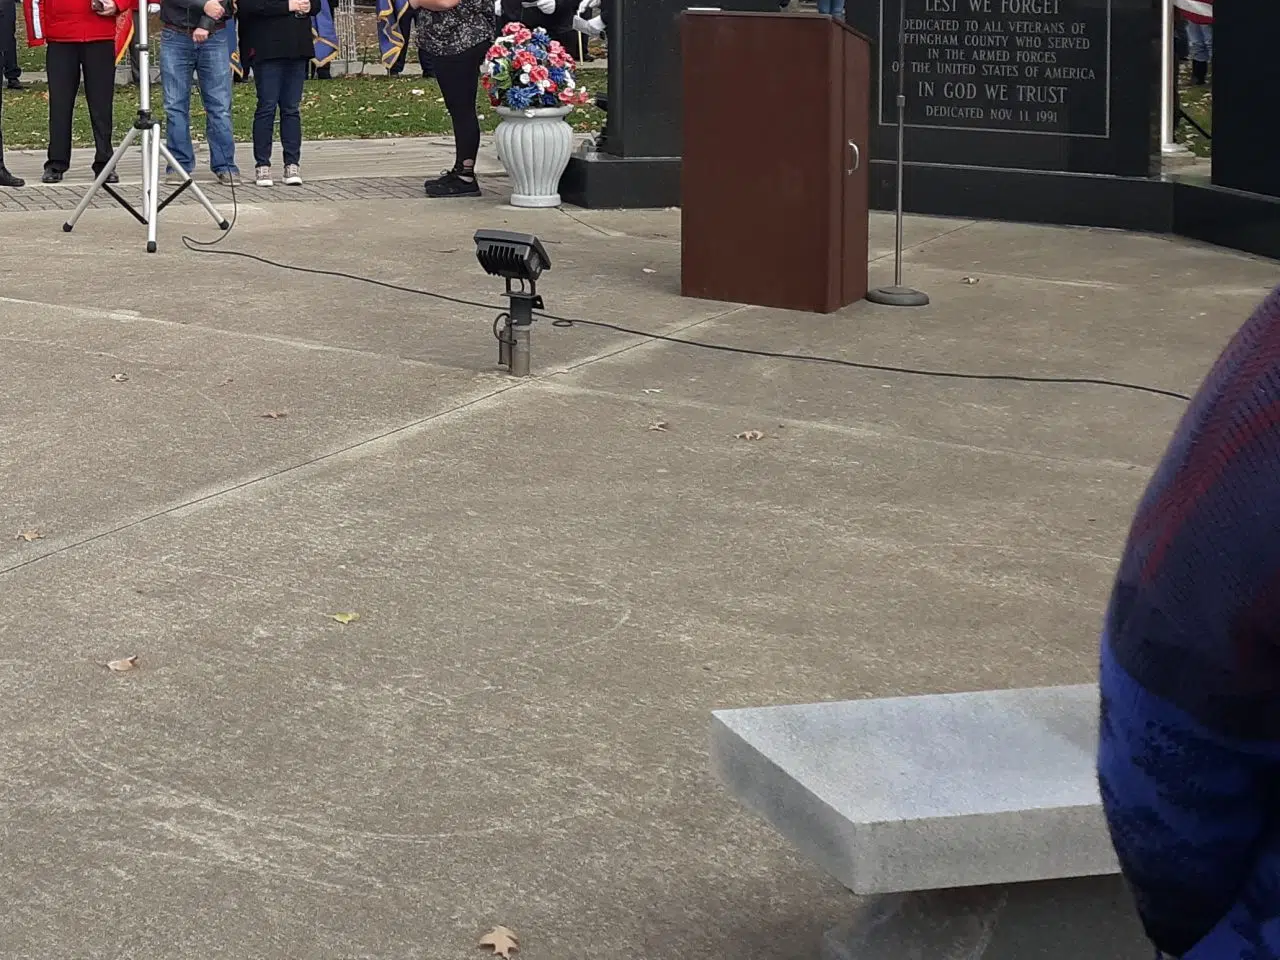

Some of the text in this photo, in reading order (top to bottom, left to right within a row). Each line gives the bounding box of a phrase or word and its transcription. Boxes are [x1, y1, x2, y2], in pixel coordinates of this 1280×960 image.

[903, 18, 1088, 35] DEDICATED TO ALL VETERANS OF
[964, 34, 1009, 47] COUNTY
[1015, 35, 1041, 48] WHO
[1047, 36, 1091, 50] SERVED
[928, 47, 1057, 64] IN THE ARMED FORCES
[892, 60, 1096, 80] O THE UNITED STATES OF AMERICA
[918, 81, 1068, 104] IN GOD WE TRUST
[926, 105, 984, 119] DEDICATED
[1036, 111, 1058, 123] 1991
